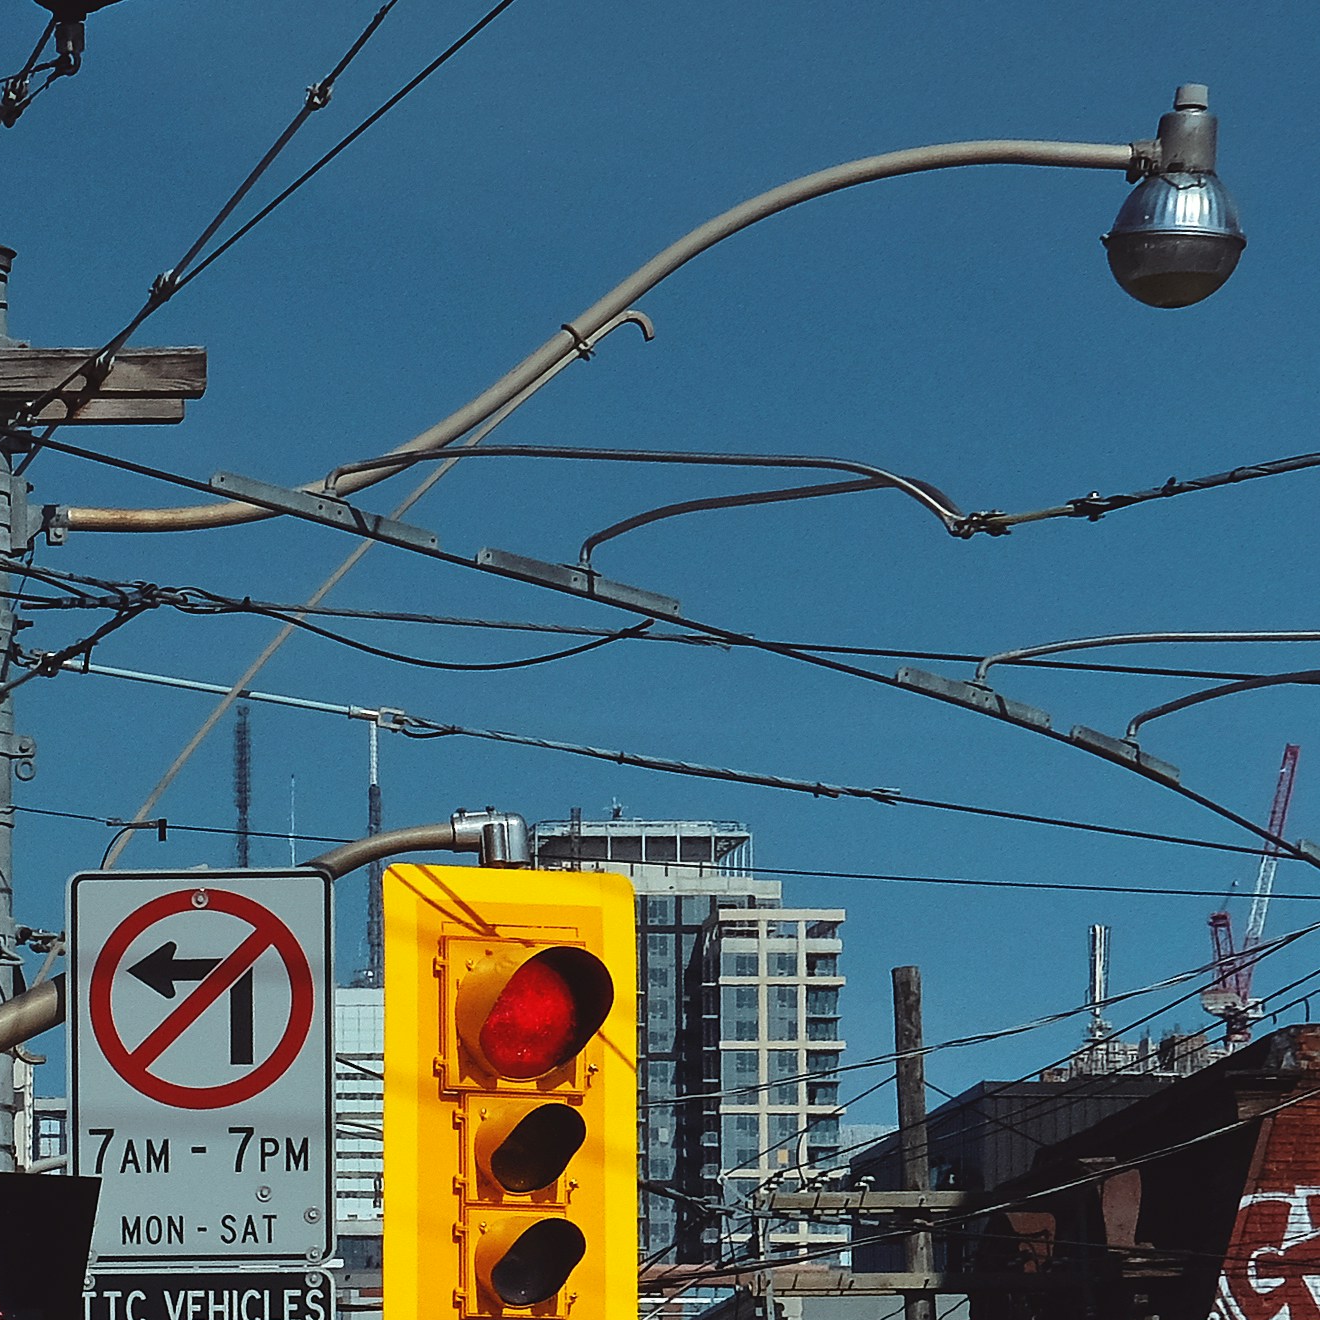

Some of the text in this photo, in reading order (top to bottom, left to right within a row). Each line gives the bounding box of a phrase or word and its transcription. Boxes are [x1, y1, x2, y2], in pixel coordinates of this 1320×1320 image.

[88, 1128, 170, 1175] 7AM
[227, 1126, 310, 1174] 7PM
[121, 1215, 184, 1245] MON
[220, 1214, 278, 1245] SAT
